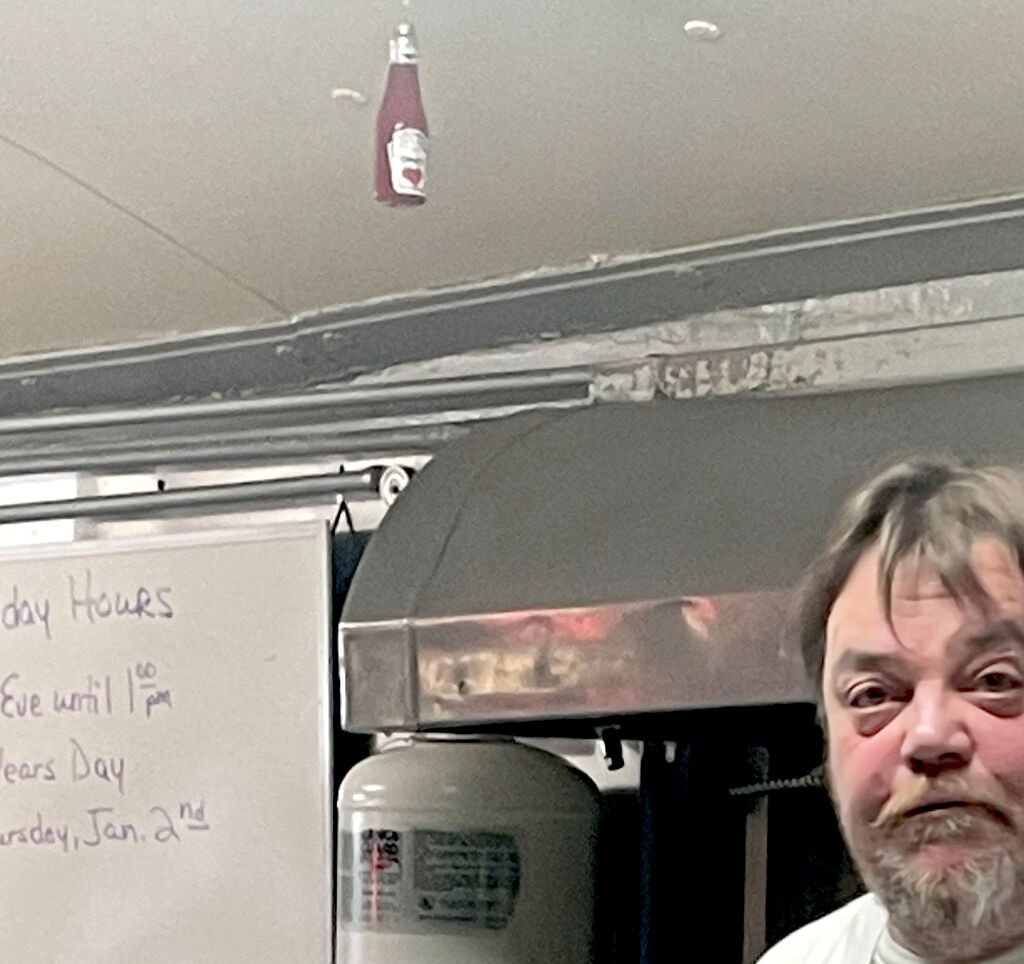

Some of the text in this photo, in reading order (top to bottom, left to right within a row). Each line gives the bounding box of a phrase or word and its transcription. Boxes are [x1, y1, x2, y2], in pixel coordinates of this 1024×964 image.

[2, 585, 51, 640] day
[0, 673, 43, 718] Eve
[54, 674, 111, 714] until
[70, 738, 124, 796] Day
[84, 807, 146, 845] Jan.
